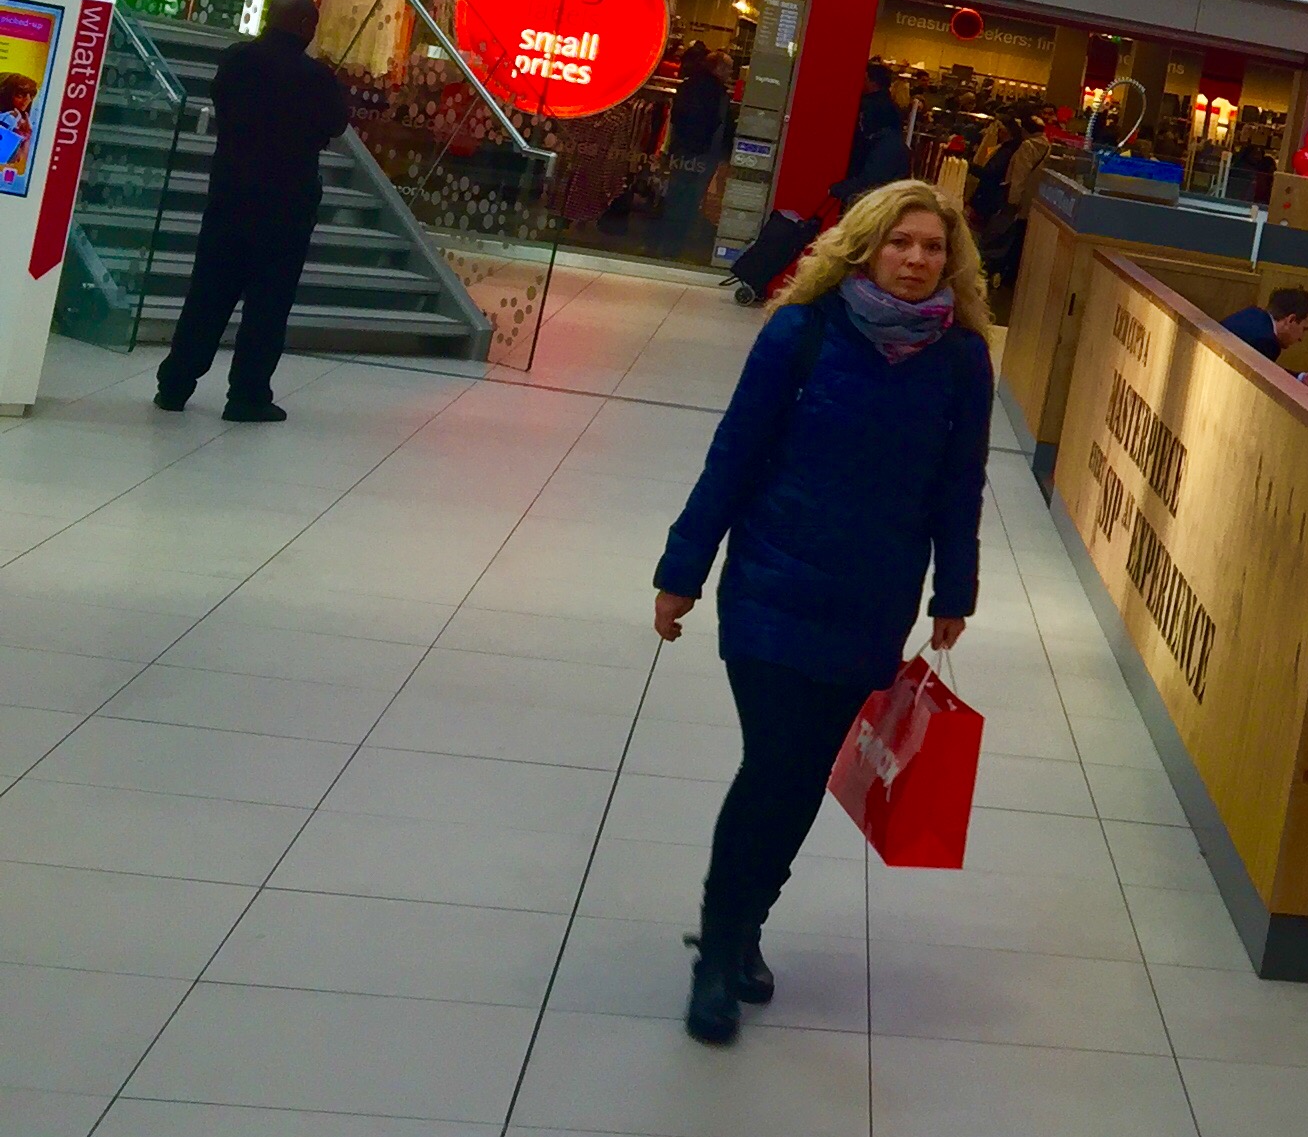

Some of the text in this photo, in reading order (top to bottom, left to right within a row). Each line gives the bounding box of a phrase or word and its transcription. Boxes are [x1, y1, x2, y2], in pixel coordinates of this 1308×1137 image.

[519, 28, 600, 62] small
[895, 11, 953, 33] treasur
[1036, 37, 1057, 51] fin
[67, 6, 105, 99] what's
[511, 52, 593, 85] prices
[668, 153, 706, 173] kids
[1105, 368, 1188, 519] MASTERPIECE
[1098, 465, 1124, 544] SIP
[1126, 507, 1217, 706] EXPERIENCE
